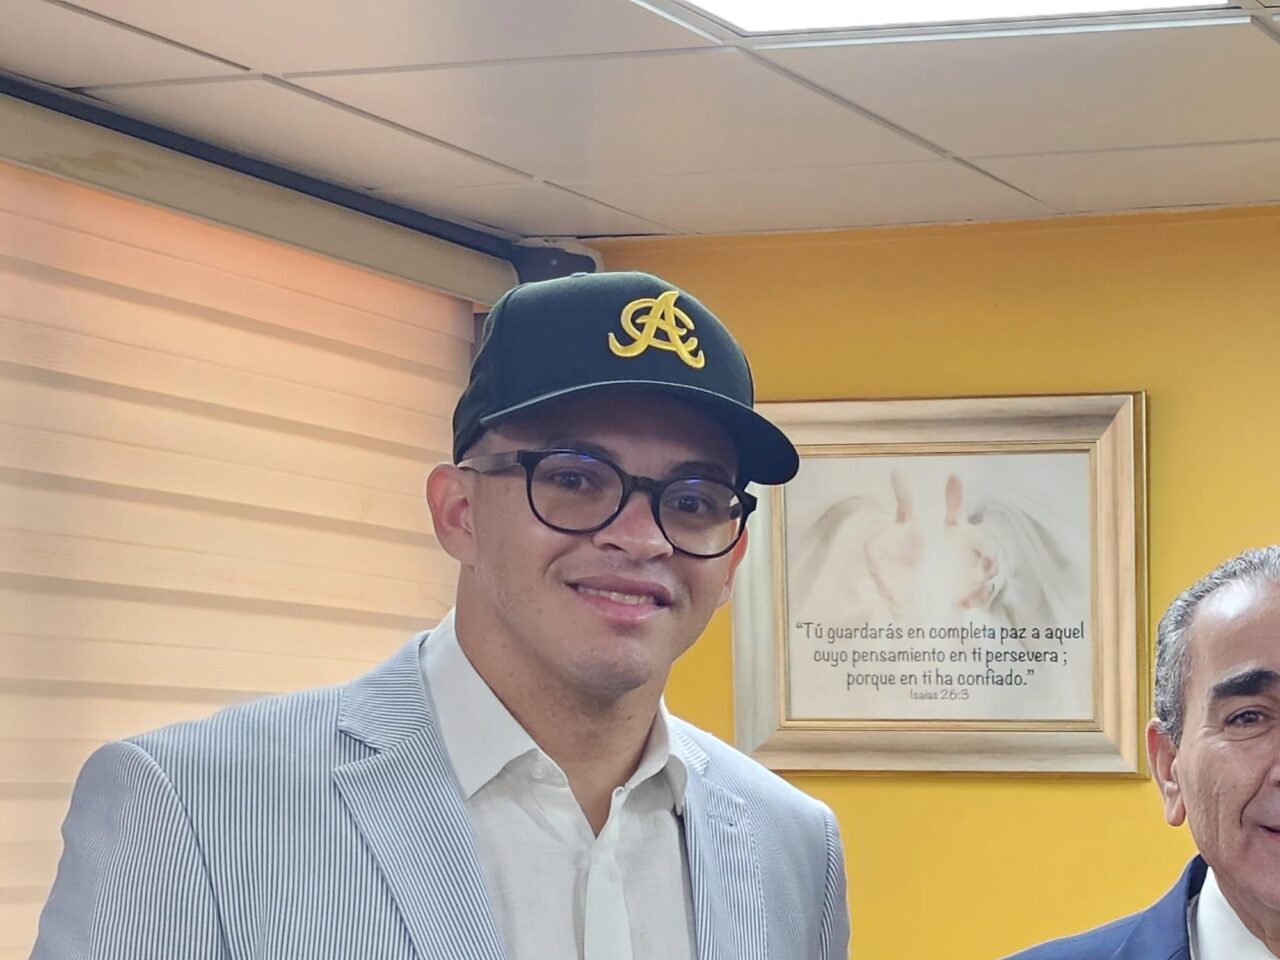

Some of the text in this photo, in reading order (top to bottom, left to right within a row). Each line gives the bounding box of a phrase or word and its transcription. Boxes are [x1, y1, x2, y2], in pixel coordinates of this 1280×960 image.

[827, 621, 903, 644] guardarás
[907, 626, 925, 639] en
[929, 621, 996, 645] completa
[1000, 626, 1027, 645] paz
[1031, 627, 1040, 639] a
[1044, 621, 1084, 645] aquel
[813, 650, 848, 667] cuyo
[852, 647, 945, 668] pensamiento
[949, 650, 967, 662] en
[972, 647, 982, 662] ti
[986, 650, 1058, 668] persevera
[846, 672, 896, 691] porque
[900, 673, 918, 685] en
[922, 670, 932, 685] ti
[935, 668, 953, 685] ha
[940, 688, 970, 700] 26:3
